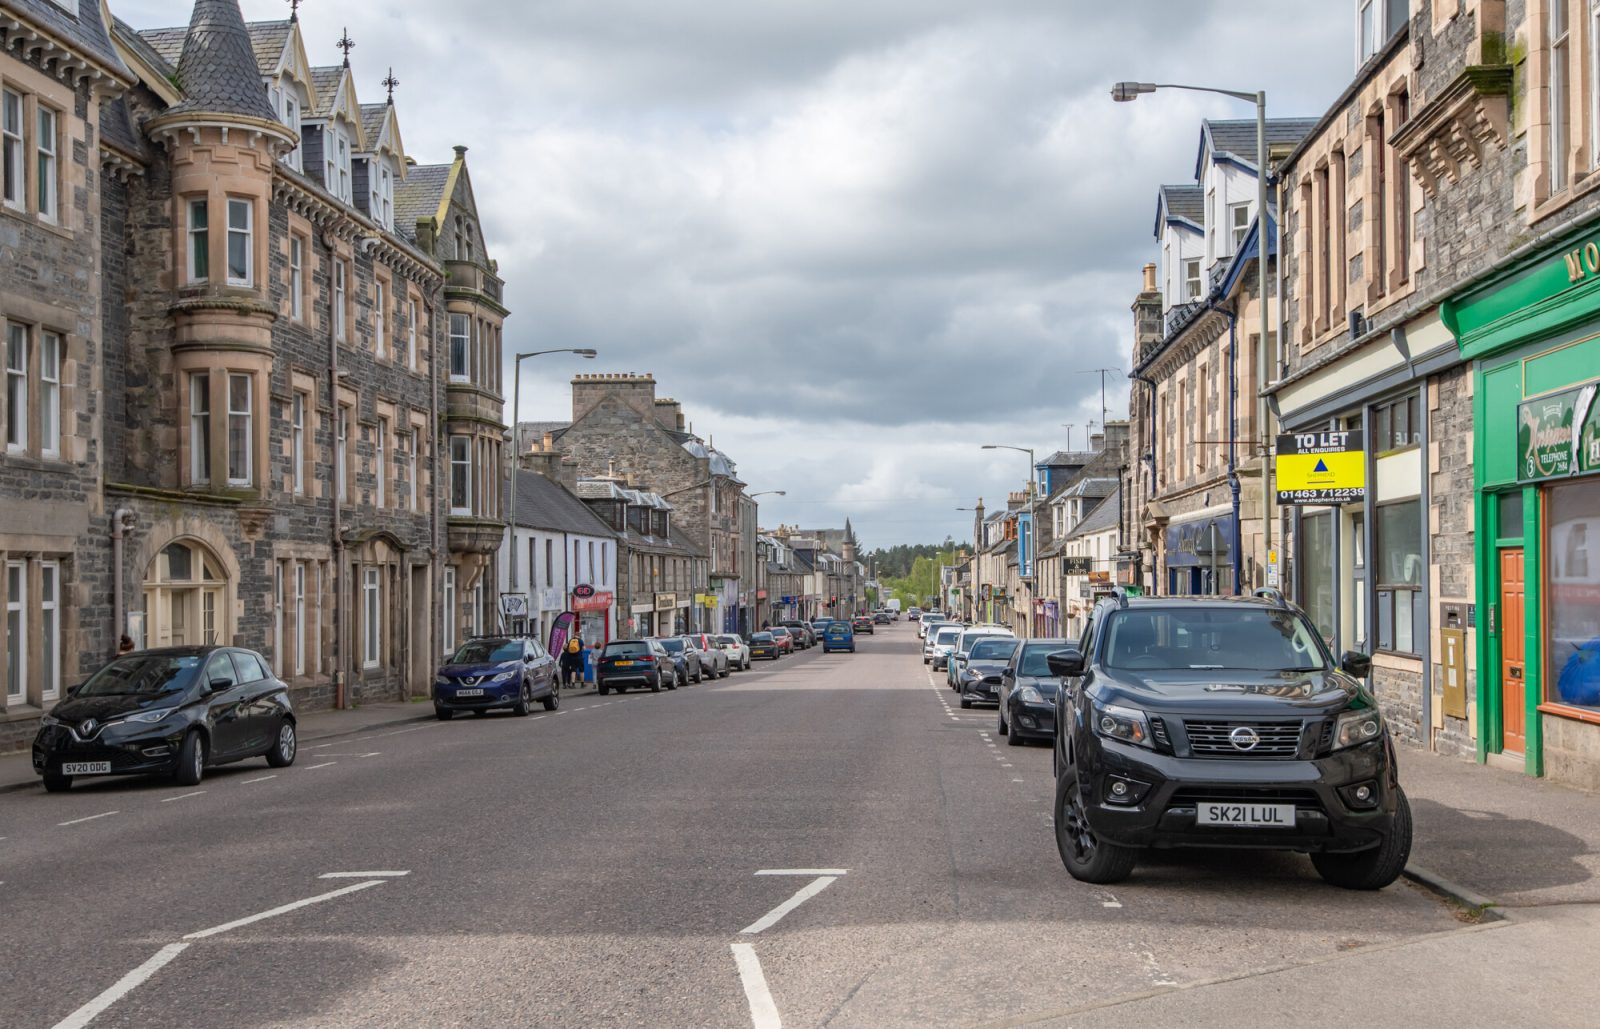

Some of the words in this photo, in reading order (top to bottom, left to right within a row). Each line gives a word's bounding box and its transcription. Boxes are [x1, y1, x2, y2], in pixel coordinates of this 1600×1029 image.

[1295, 434, 1316, 448] TO
[1320, 432, 1349, 447] LET
[1311, 446, 1346, 454] ENQUIRIES
[1541, 451, 1568, 463] TELEPHONE
[1528, 459, 1534, 474] 3
[1280, 489, 1317, 499] 01463
[1320, 488, 1365, 498] 712239
[1070, 557, 1084, 565] FISH
[1067, 568, 1087, 576] CHIPS
[66, 763, 88, 773] SV20
[90, 762, 107, 772] ODG
[1209, 806, 1246, 822] SK21
[1252, 807, 1283, 823] LUL
